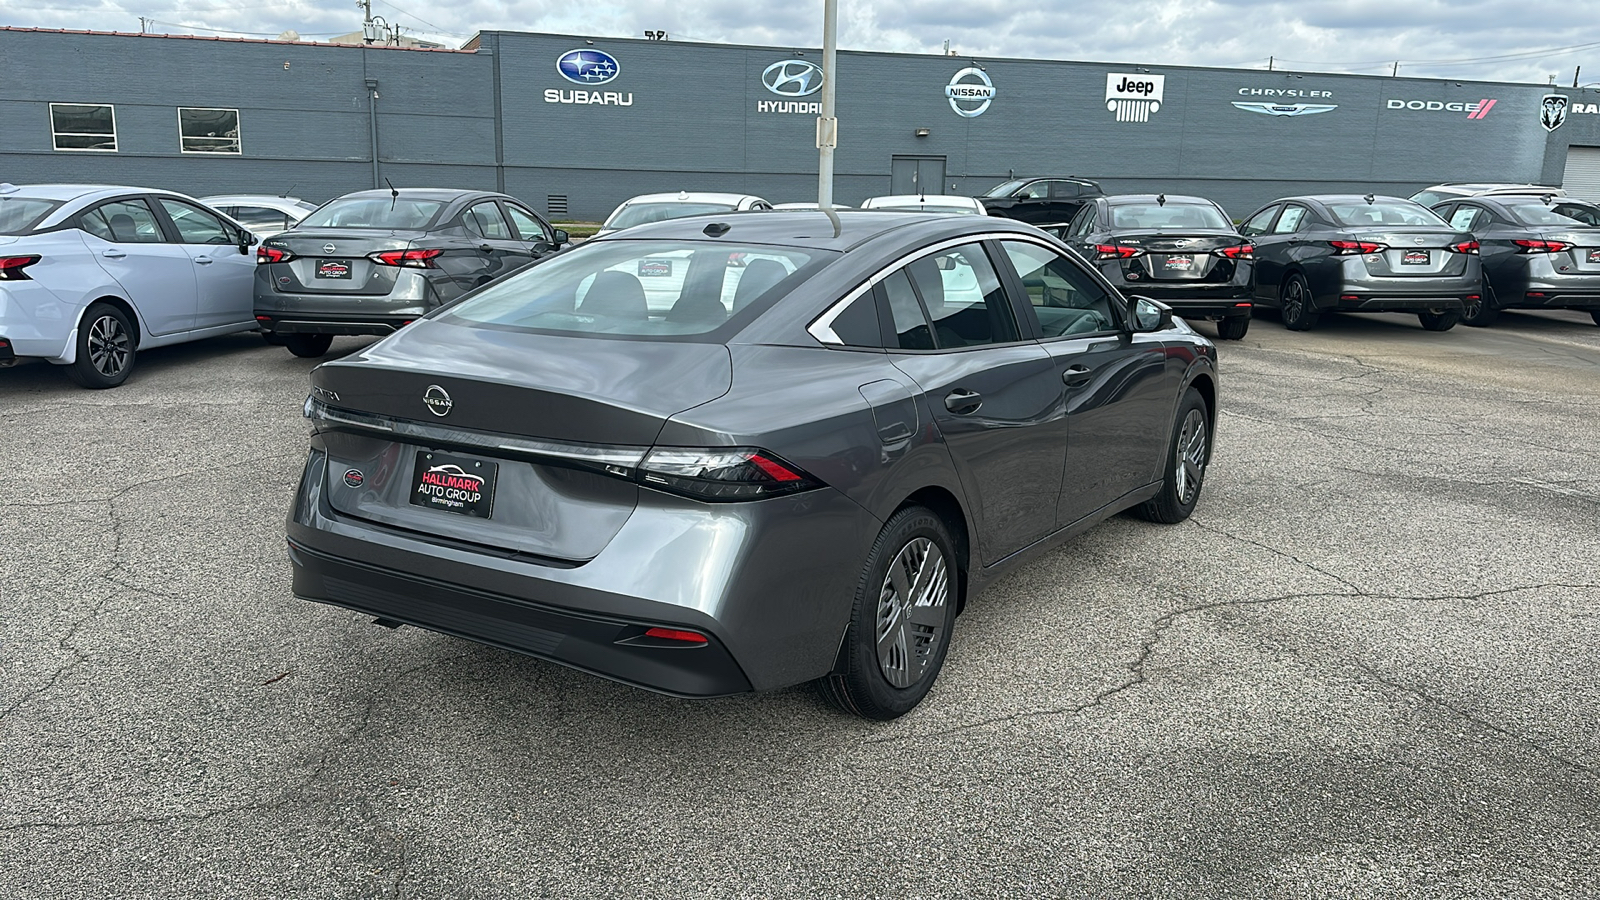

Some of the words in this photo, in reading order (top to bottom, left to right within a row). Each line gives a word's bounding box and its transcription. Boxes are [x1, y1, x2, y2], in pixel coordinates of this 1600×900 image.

[950, 88, 991, 97] NISSAN
[1117, 77, 1154, 96] Jeep
[544, 89, 633, 106] SUBARU
[1238, 87, 1333, 99] CHRYSLER
[1387, 99, 1481, 112] DODGE
[1571, 103, 1600, 114] RA
[422, 397, 453, 407] NISSAN
[422, 471, 480, 492] HALLMARK
[418, 483, 444, 497] AUTO
[445, 488, 481, 503] GROUP
[431, 496, 464, 508] Birmingham
